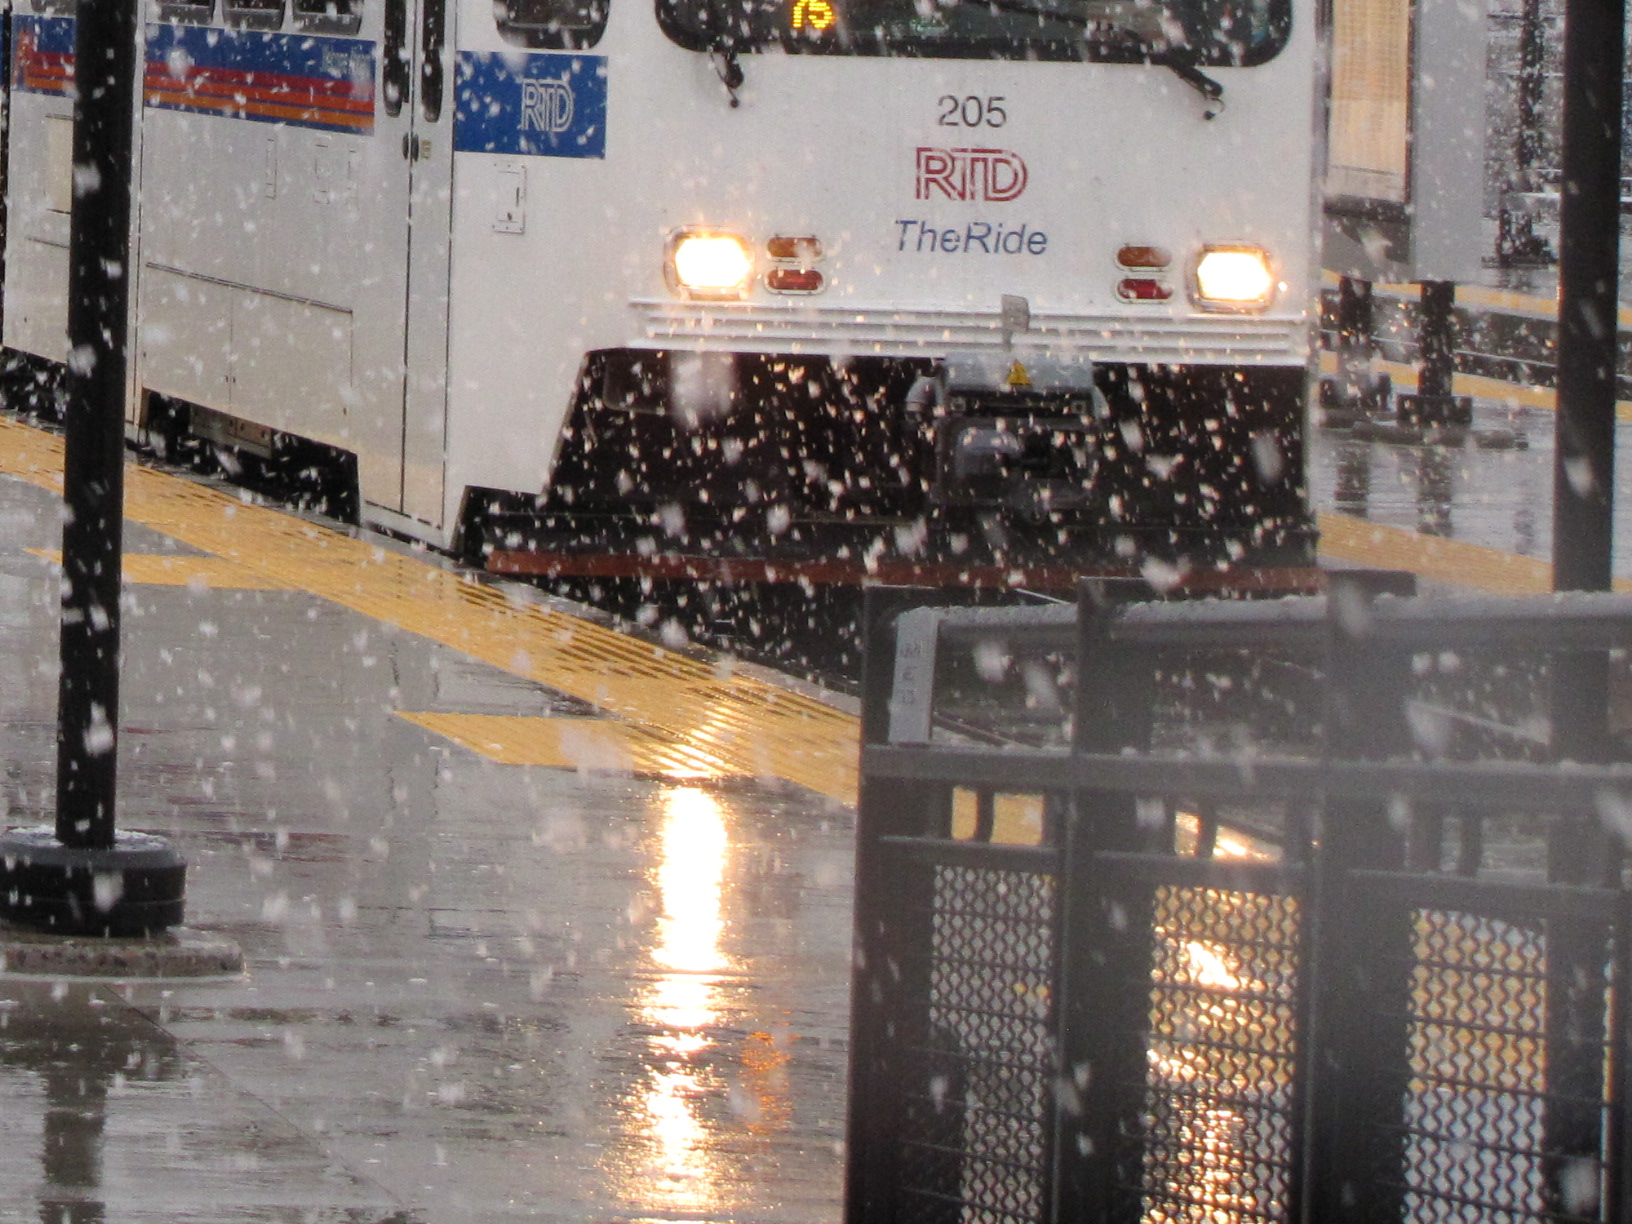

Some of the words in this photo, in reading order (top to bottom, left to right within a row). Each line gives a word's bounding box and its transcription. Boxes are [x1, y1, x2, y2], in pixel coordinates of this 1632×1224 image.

[521, 78, 574, 132] RTD
[937, 94, 1008, 128] 205
[915, 146, 1029, 202] RTD
